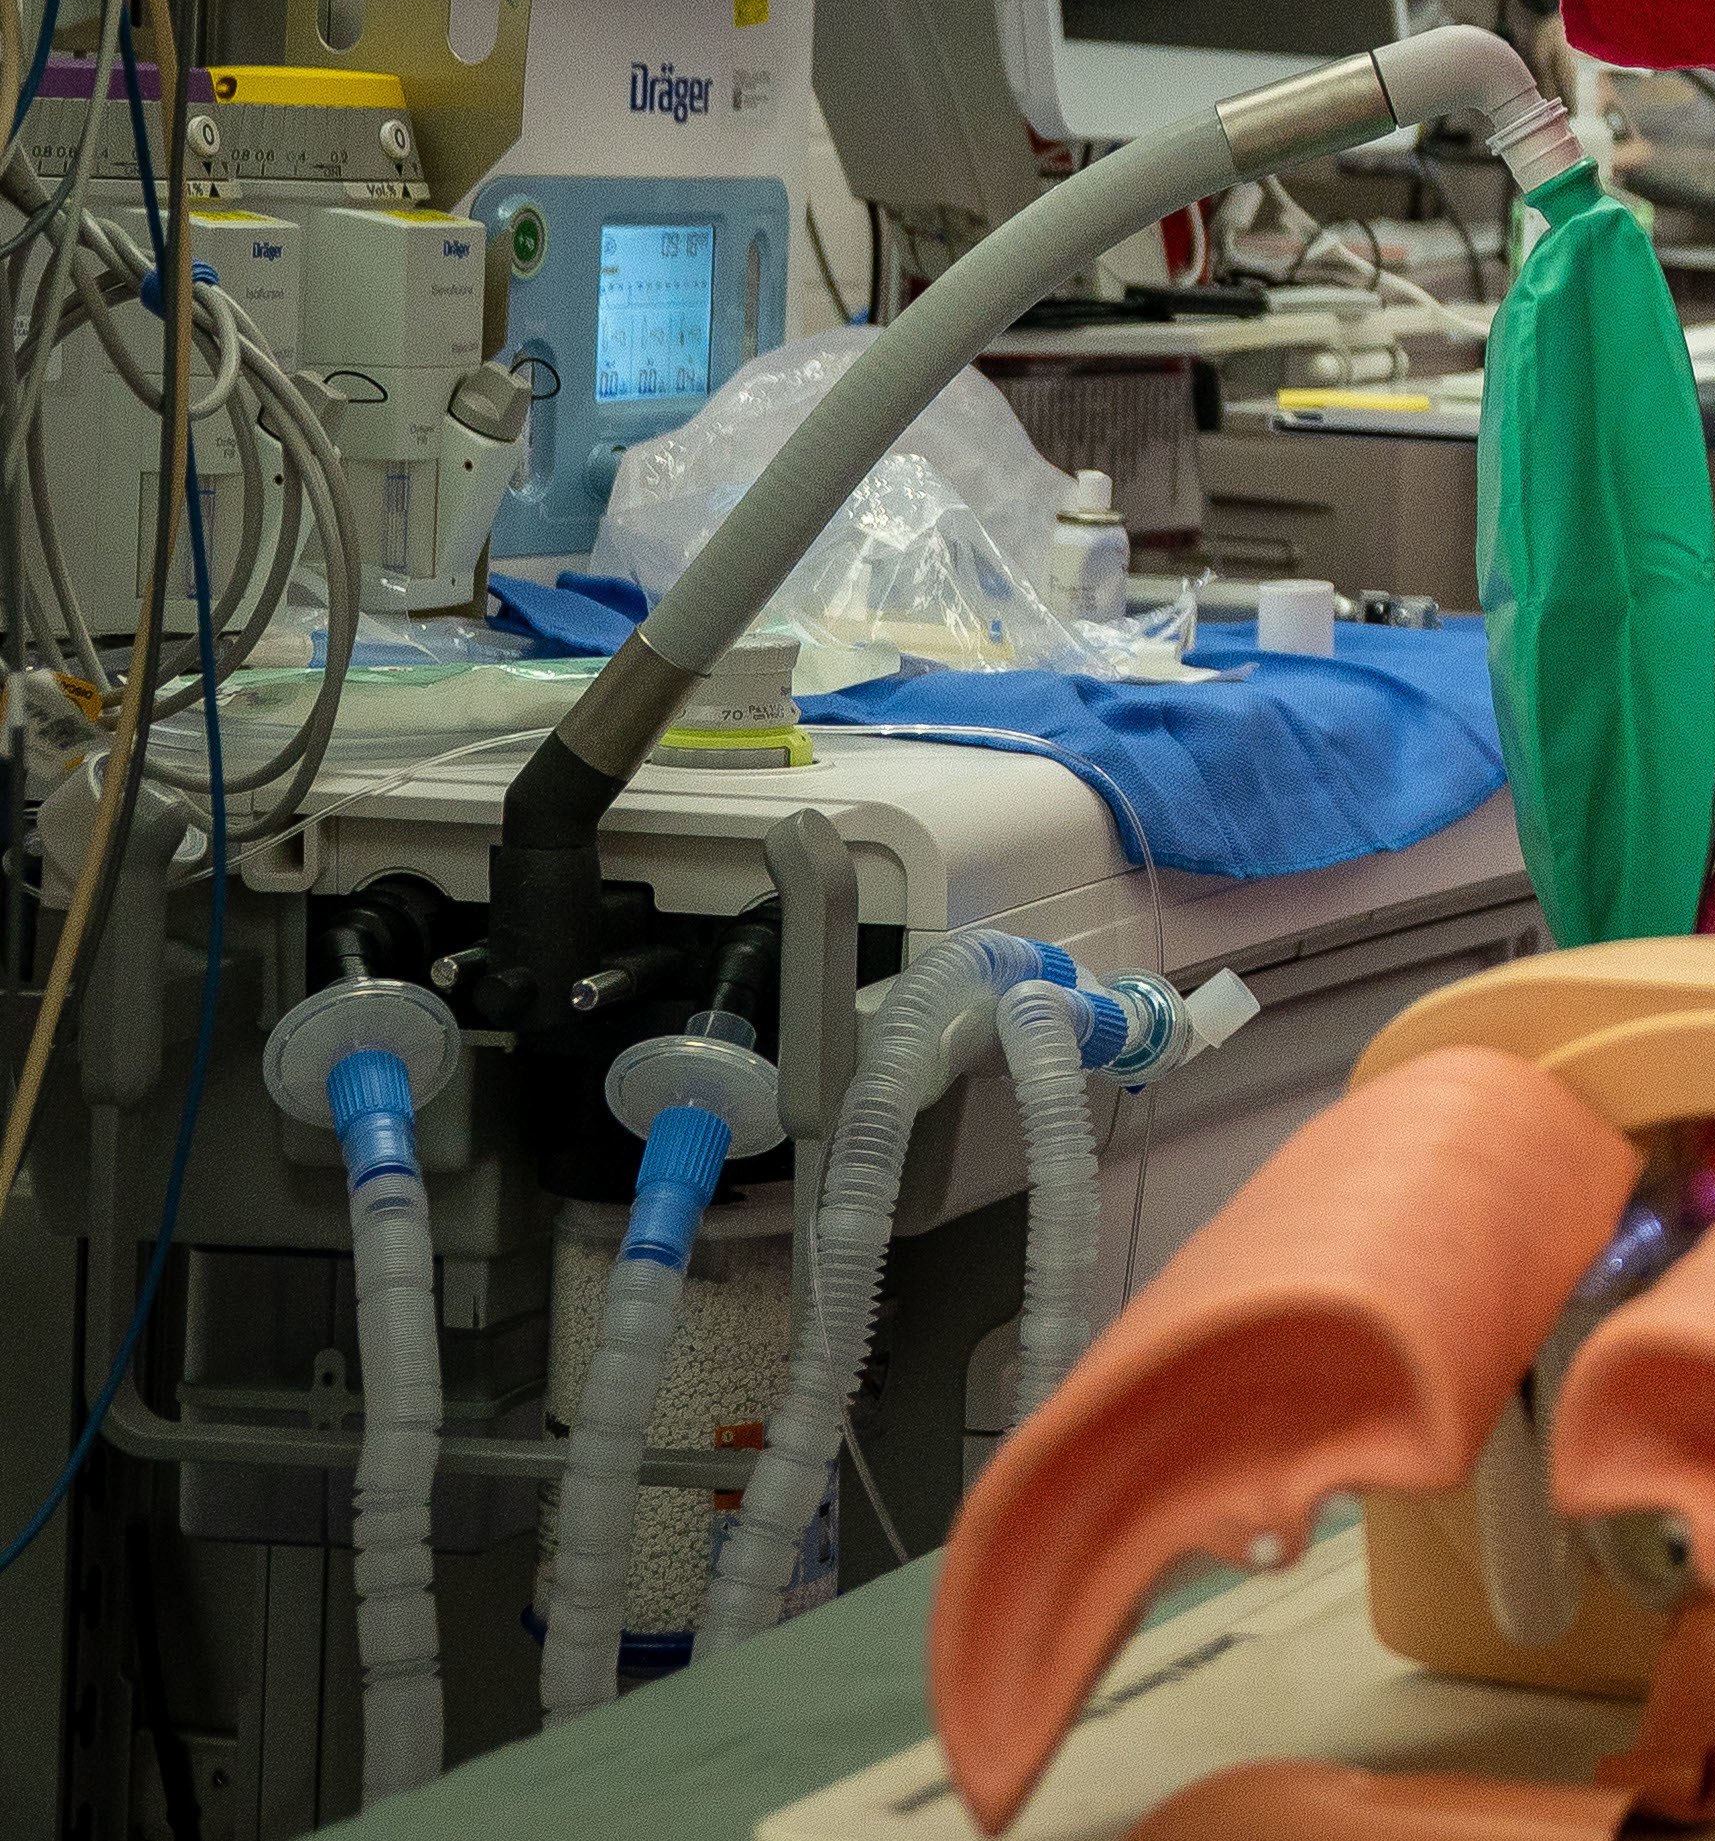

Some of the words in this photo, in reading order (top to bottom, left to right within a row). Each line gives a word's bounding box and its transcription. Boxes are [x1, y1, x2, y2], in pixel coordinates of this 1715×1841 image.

[630, 62, 713, 124] Dräger
[252, 241, 283, 262] Dräger
[442, 239, 471, 261] Dräger
[721, 709, 744, 721] 70
